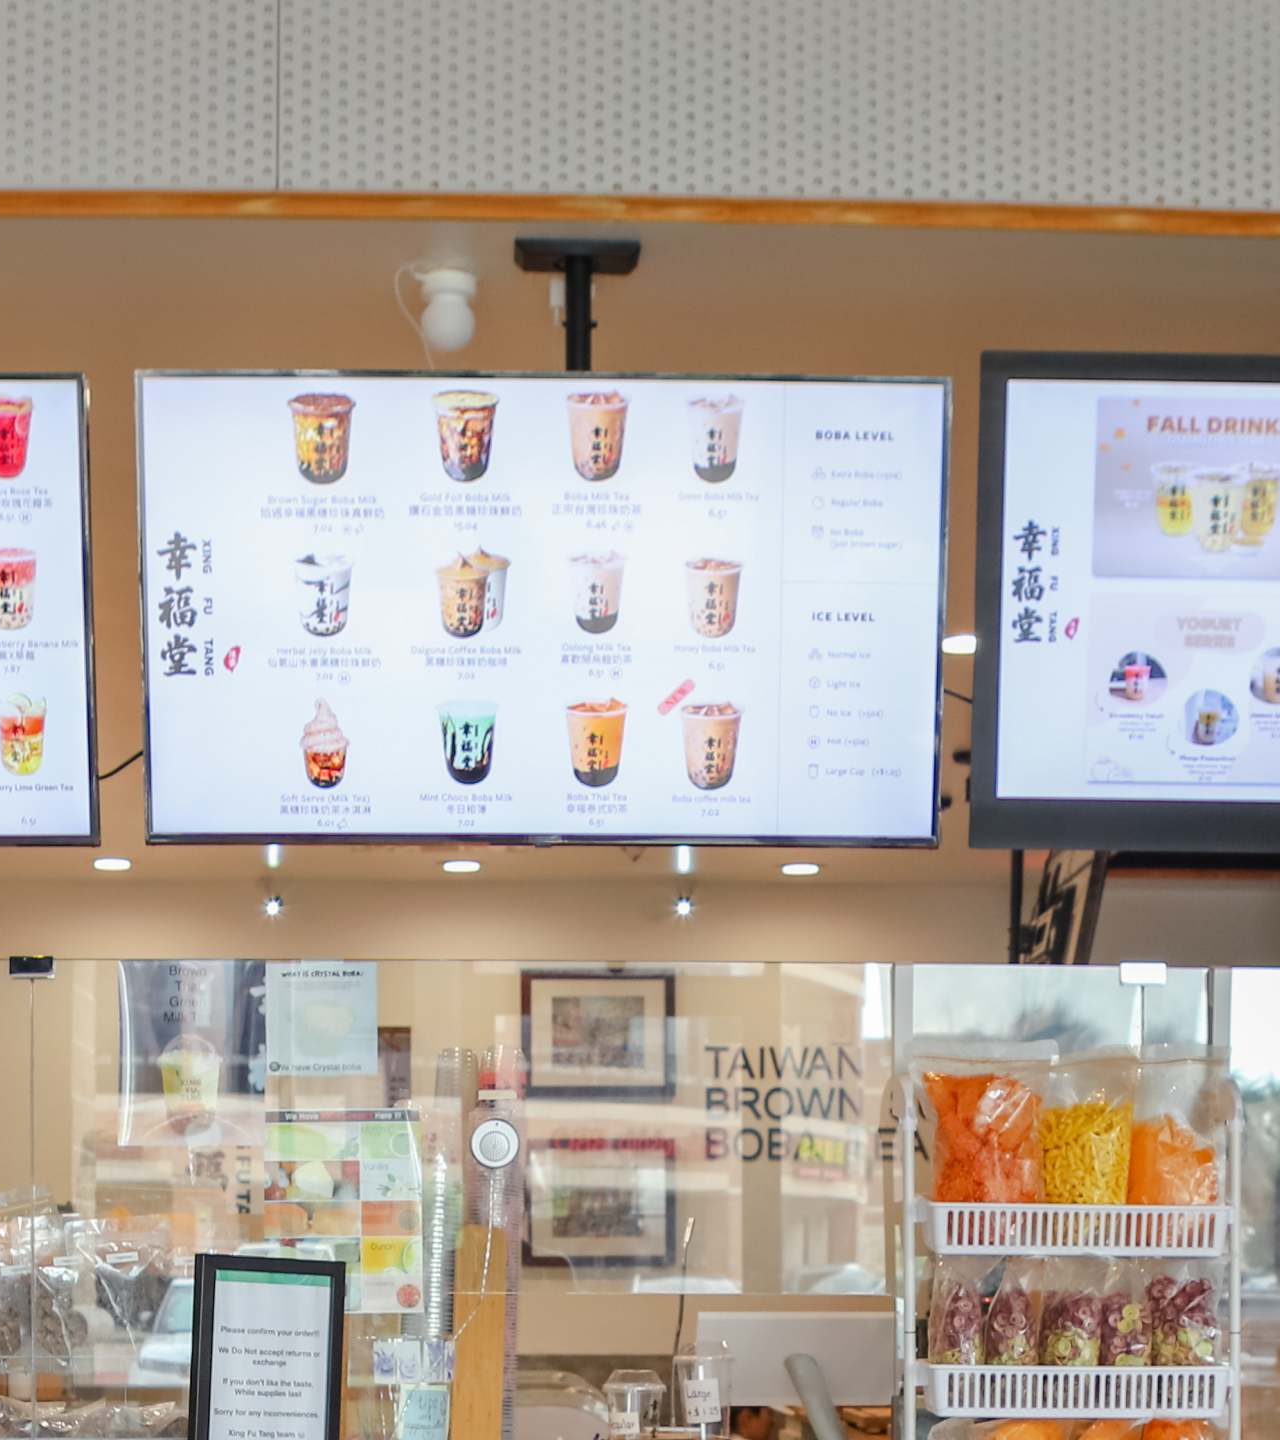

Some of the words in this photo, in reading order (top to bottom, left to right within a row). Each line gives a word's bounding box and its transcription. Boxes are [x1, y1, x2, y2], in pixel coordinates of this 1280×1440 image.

[1146, 415, 1201, 433] FALL
[815, 430, 851, 441] BOBA
[856, 430, 895, 441] LEVEL
[202, 540, 212, 574] XING
[1013, 520, 1047, 643] 幸福堂
[156, 531, 198, 678] 幸福堂
[203, 598, 214, 616] FU
[812, 611, 832, 622] ICE
[837, 611, 876, 622] LEVEL
[410, 645, 444, 657] Dalgona
[448, 645, 476, 655] Coffee
[480, 645, 500, 655] Boba
[503, 645, 521, 655] Milk
[203, 639, 215, 677] TANG
[15, 784, 33, 792] Lime
[35, 784, 58, 792] Green
[61, 784, 74, 792] Tea
[420, 793, 438, 802] Mint
[441, 793, 469, 802] Choco
[472, 793, 492, 802] Boba
[495, 793, 513, 802] Milk
[566, 792, 589, 801] Boba
[591, 792, 610, 801] Thai
[612, 792, 628, 801] Tea
[169, 966, 208, 976] Brown
[705, 1046, 862, 1080] TAIWAN
[705, 1087, 862, 1121] BROWN
[705, 1128, 821, 1162] BOBA
[221, 1326, 245, 1334] Please
[247, 1327, 275, 1336] confirm
[219, 1347, 229, 1355] We
[231, 1347, 242, 1355] Do
[244, 1347, 257, 1355] Not
[258, 1349, 283, 1358] accept
[252, 1359, 286, 1367] exchange
[229, 1380, 243, 1388] you
[266, 1379, 278, 1387] like
[235, 1389, 255, 1397] While
[257, 1390, 286, 1399] supplies
[288, 1390, 302, 1398] last
[214, 1408, 233, 1418] Sorry
[248, 1410, 261, 1418] any
[228, 1430, 245, 1439] Xing
[259, 1431, 275, 1440] Tang
